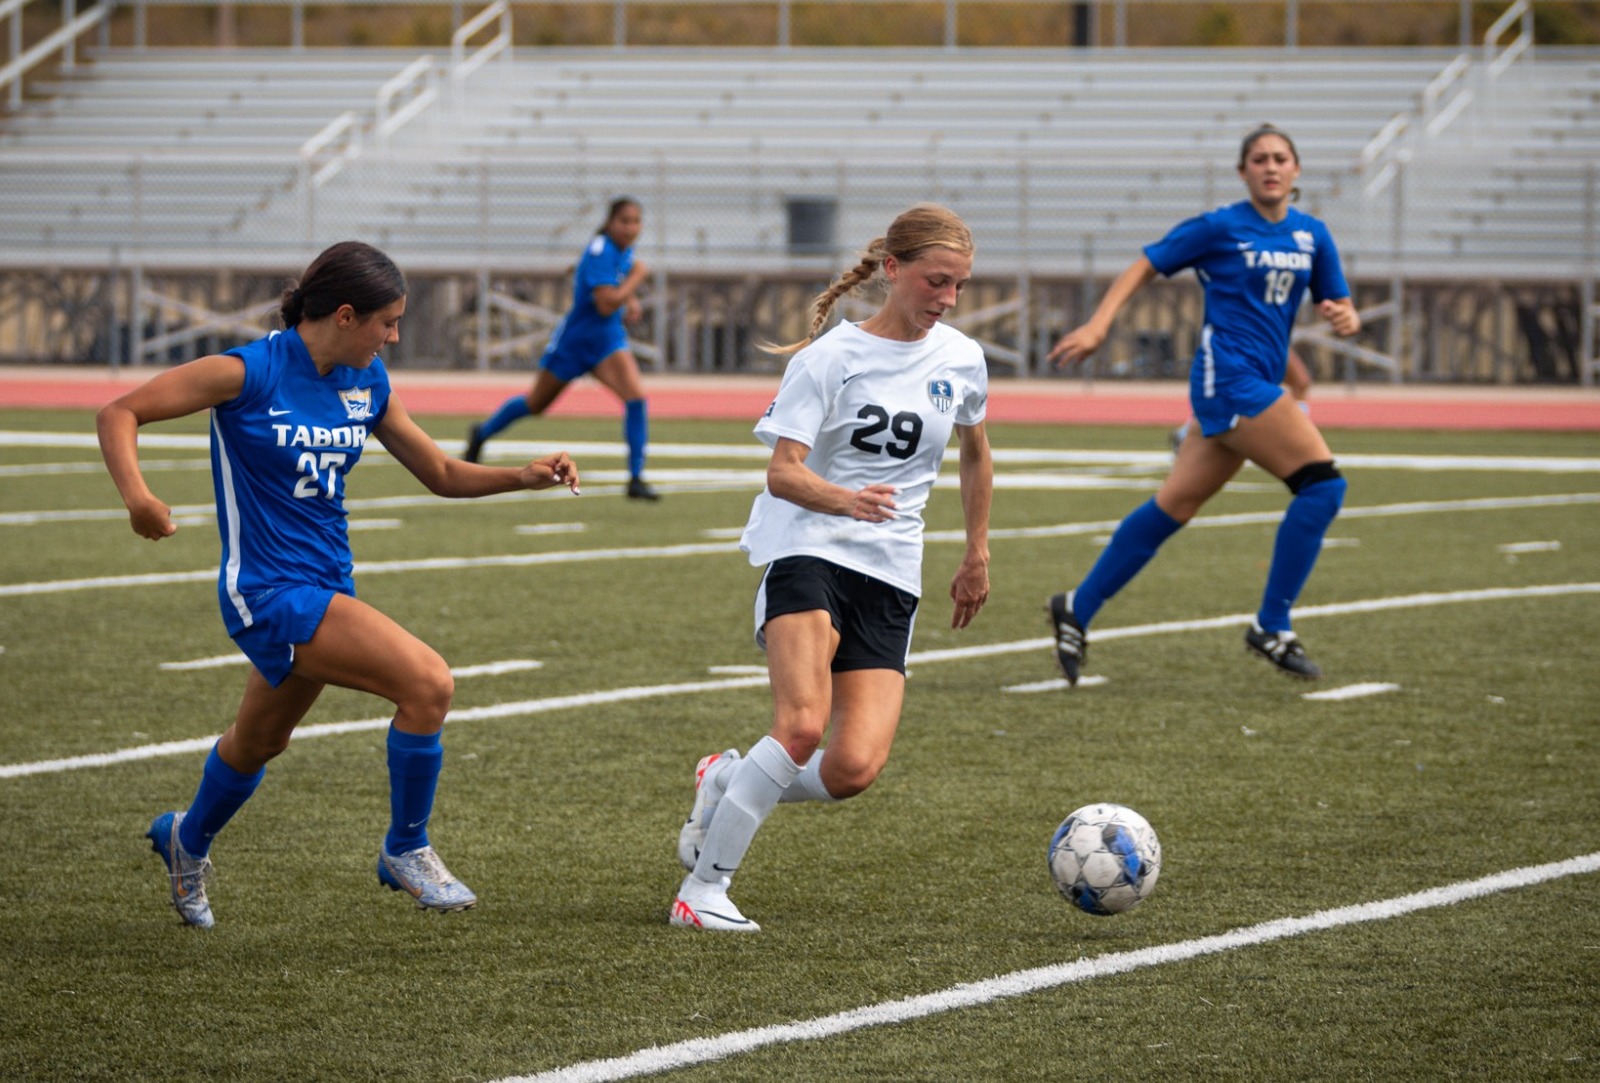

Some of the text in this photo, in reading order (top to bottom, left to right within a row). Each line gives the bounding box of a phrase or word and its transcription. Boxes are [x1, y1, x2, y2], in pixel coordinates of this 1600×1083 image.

[1242, 250, 1312, 270] TABOR
[1264, 270, 1295, 305] 19
[271, 424, 367, 448] TABOR
[850, 404, 923, 460] 29
[293, 452, 347, 499] 27
